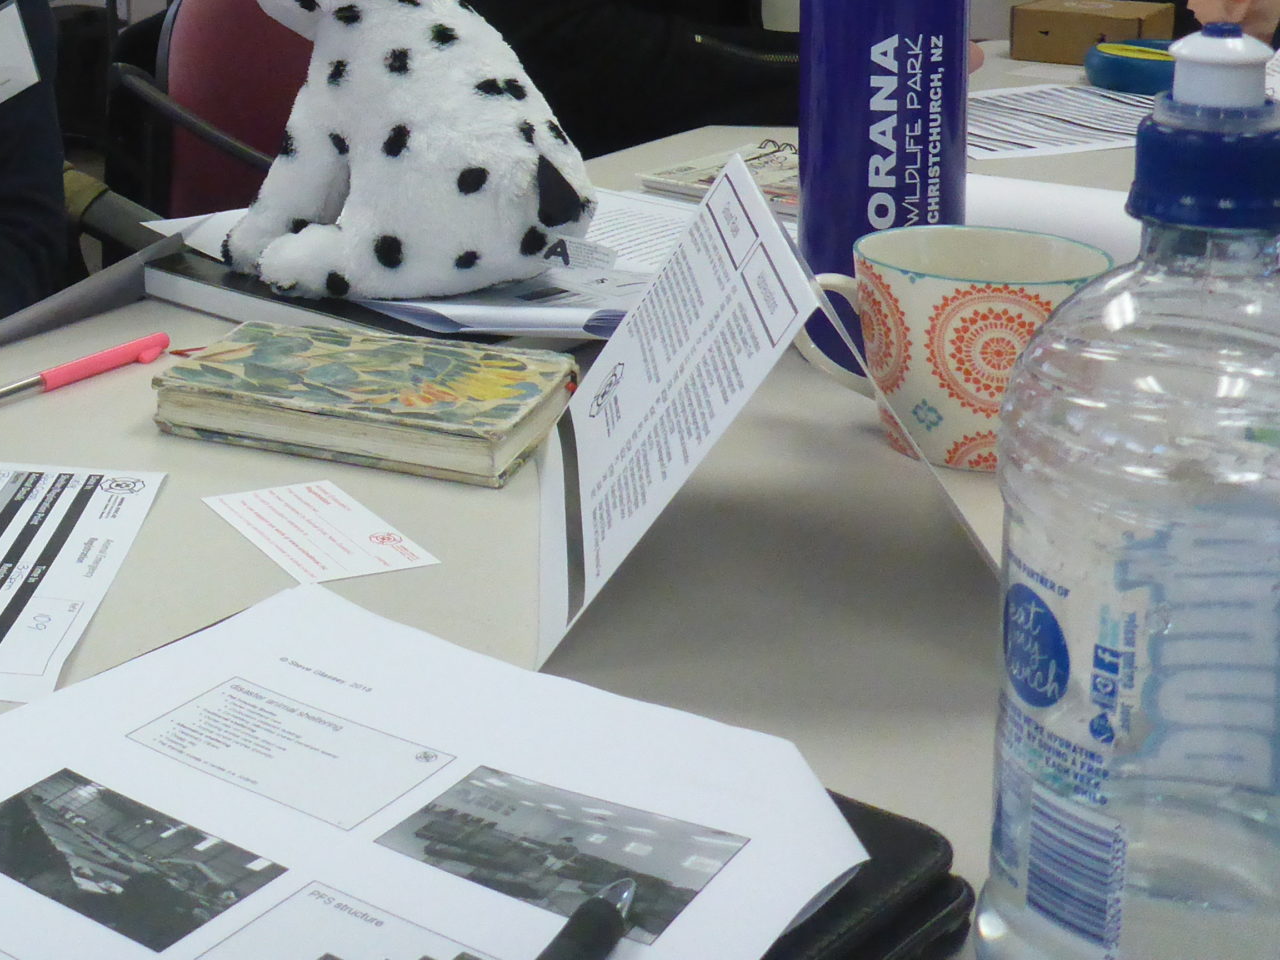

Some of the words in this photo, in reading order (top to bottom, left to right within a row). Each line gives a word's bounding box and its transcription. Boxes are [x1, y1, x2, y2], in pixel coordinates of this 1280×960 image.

[905, 34, 923, 109] PARK
[930, 35, 943, 62] NZ
[867, 34, 899, 230] ORANA
[927, 68, 944, 224] CHRISTCHURCH,
[902, 118, 923, 228] WILDLIFE
[29, 565, 46, 576] Time
[74, 537, 100, 563] Registration
[230, 683, 266, 702] disaster
[267, 698, 296, 715] animal
[297, 709, 344, 732] sheltering
[308, 889, 335, 907] PFS
[334, 900, 385, 929] structure
